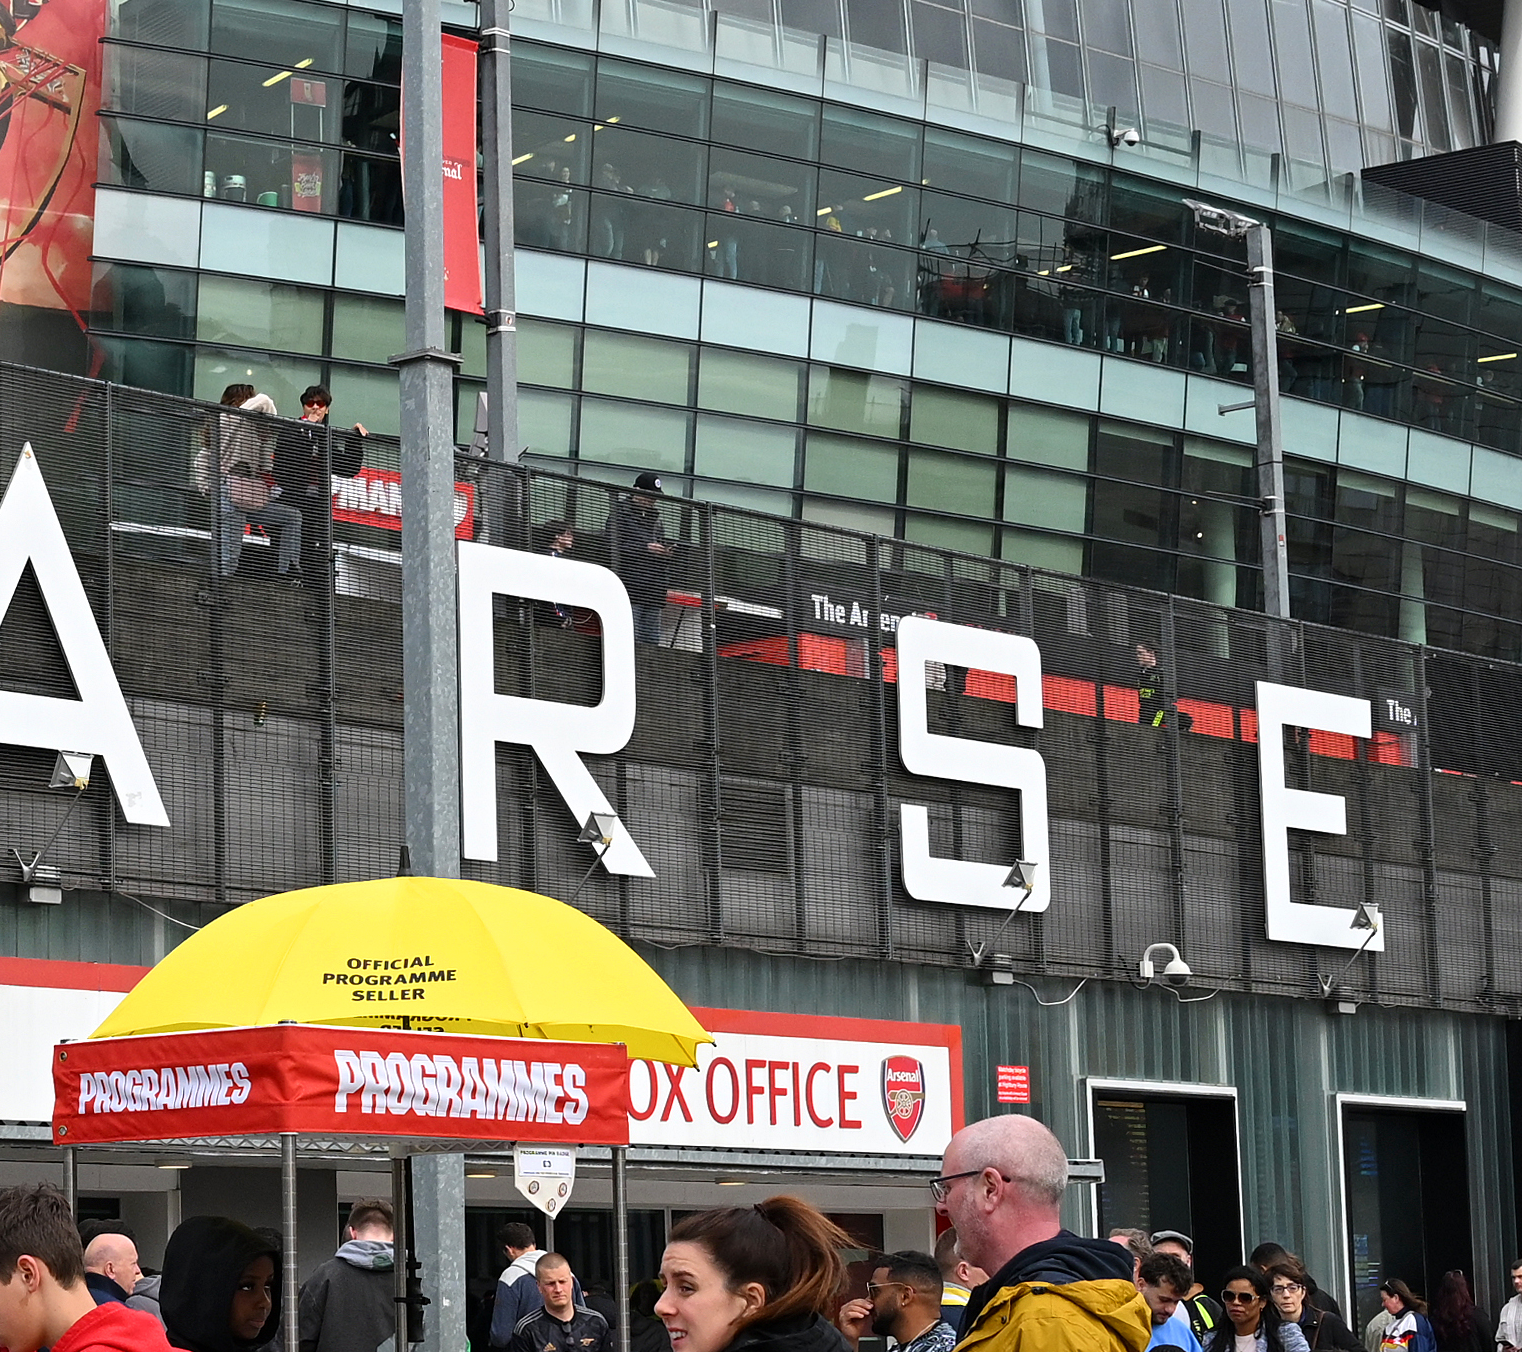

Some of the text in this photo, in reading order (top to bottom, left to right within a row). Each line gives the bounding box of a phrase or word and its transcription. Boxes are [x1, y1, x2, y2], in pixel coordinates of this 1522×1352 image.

[811, 594, 846, 623] The
[347, 956, 434, 970] OFFICIAL
[322, 970, 457, 986] PROGRAMME
[352, 988, 425, 1002] SELLER
[887, 1067, 919, 1083] Arsenal
[78, 1062, 252, 1115] PROGRAMMES
[334, 1049, 589, 1126] PROGRAMMES
[627, 1056, 863, 1130] OX OFFICE
